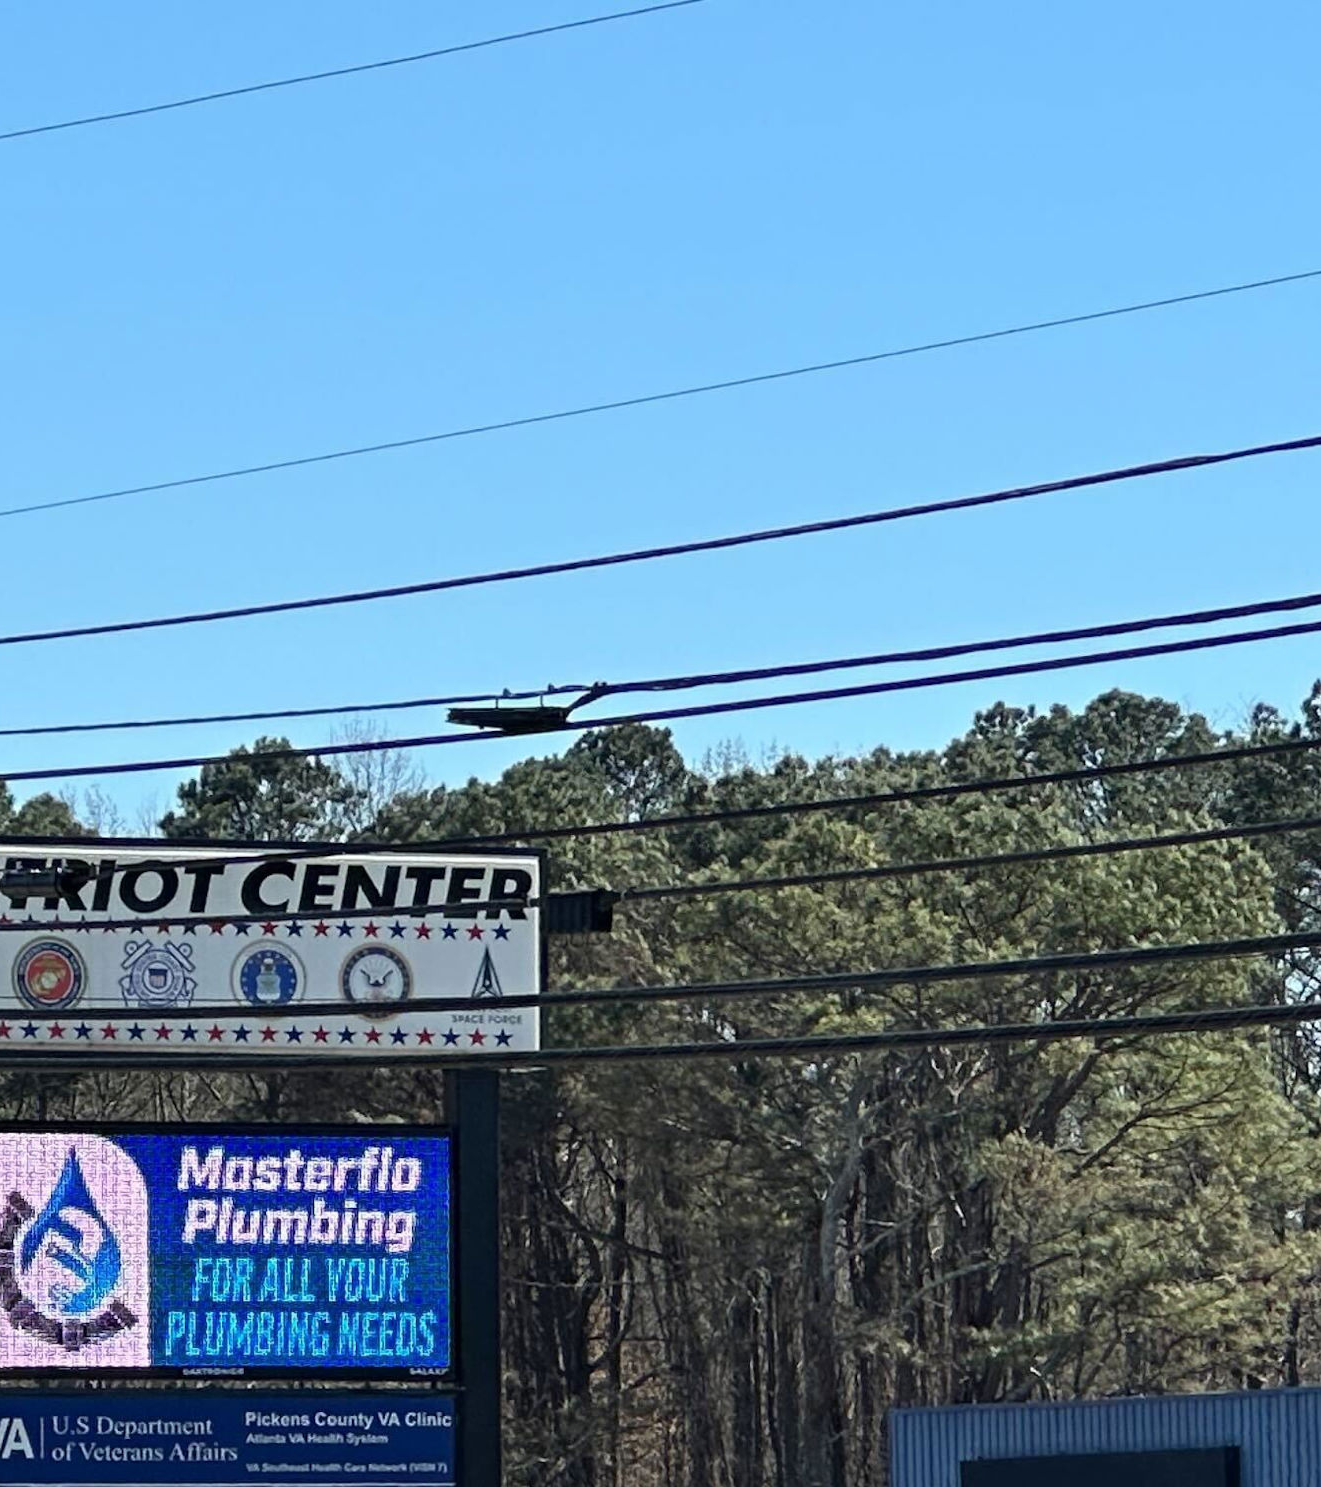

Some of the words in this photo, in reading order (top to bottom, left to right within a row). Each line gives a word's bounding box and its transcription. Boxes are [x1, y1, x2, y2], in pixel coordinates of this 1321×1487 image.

[241, 861, 532, 919] CENTER
[451, 1014, 484, 1025] SPACE
[487, 1014, 523, 1025] FORCE
[177, 1146, 422, 1191] Masterflo
[182, 1197, 416, 1253] Plumbing
[192, 1257, 253, 1302] FOR
[258, 1257, 316, 1302] ALL
[327, 1258, 409, 1302] YOUR
[166, 1310, 330, 1357] PLUMBING
[339, 1310, 437, 1357] NEEDS
[96, 1415, 213, 1439] Department
[245, 1411, 310, 1427] Pickens
[314, 1411, 374, 1430] County
[377, 1411, 400, 1427] VA
[404, 1411, 452, 1427] Clinic
[51, 1442, 76, 1461] of
[78, 1442, 164, 1461] Veterans
[168, 1442, 238, 1461] Affairs
[245, 1432, 286, 1444] Atlanta
[288, 1432, 305, 1444] VA
[307, 1432, 344, 1444] Health
[346, 1432, 389, 1446] System
